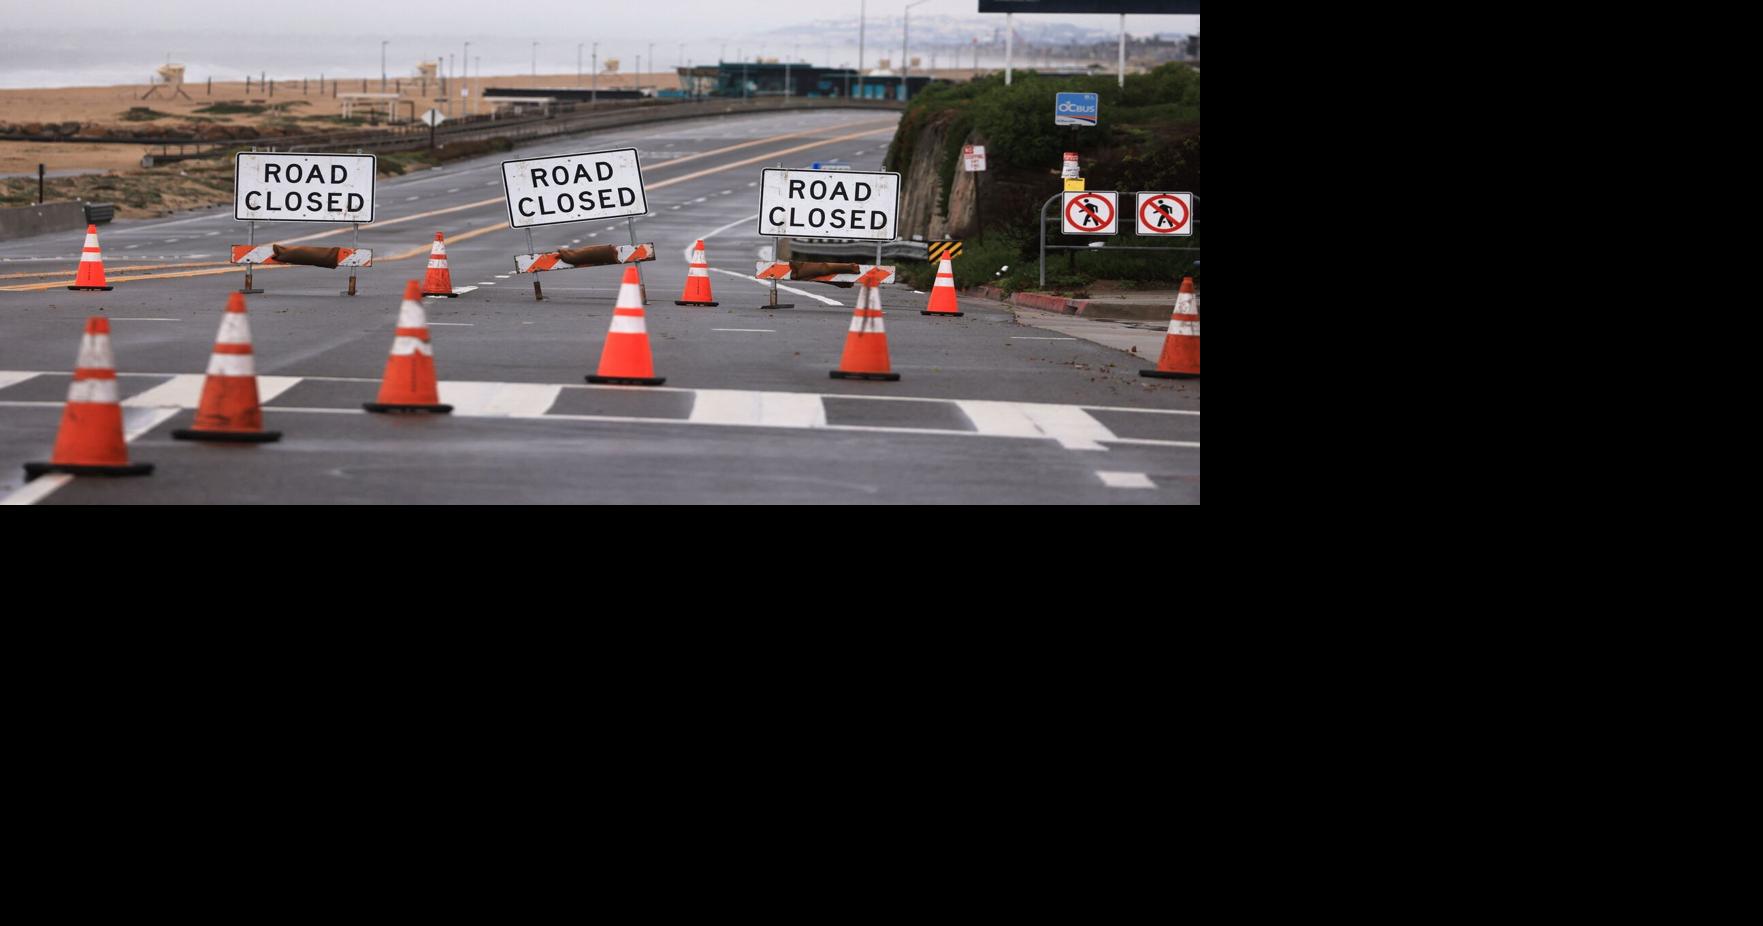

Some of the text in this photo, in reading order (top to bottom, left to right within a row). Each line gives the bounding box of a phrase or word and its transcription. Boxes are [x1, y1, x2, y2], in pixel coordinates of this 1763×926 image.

[264, 163, 348, 184] ROAD
[530, 161, 614, 188] ROAD
[245, 190, 365, 212] CLOSED
[518, 187, 636, 217] CLOSED
[788, 179, 872, 202] ROAD
[768, 206, 888, 230] CLOSED
